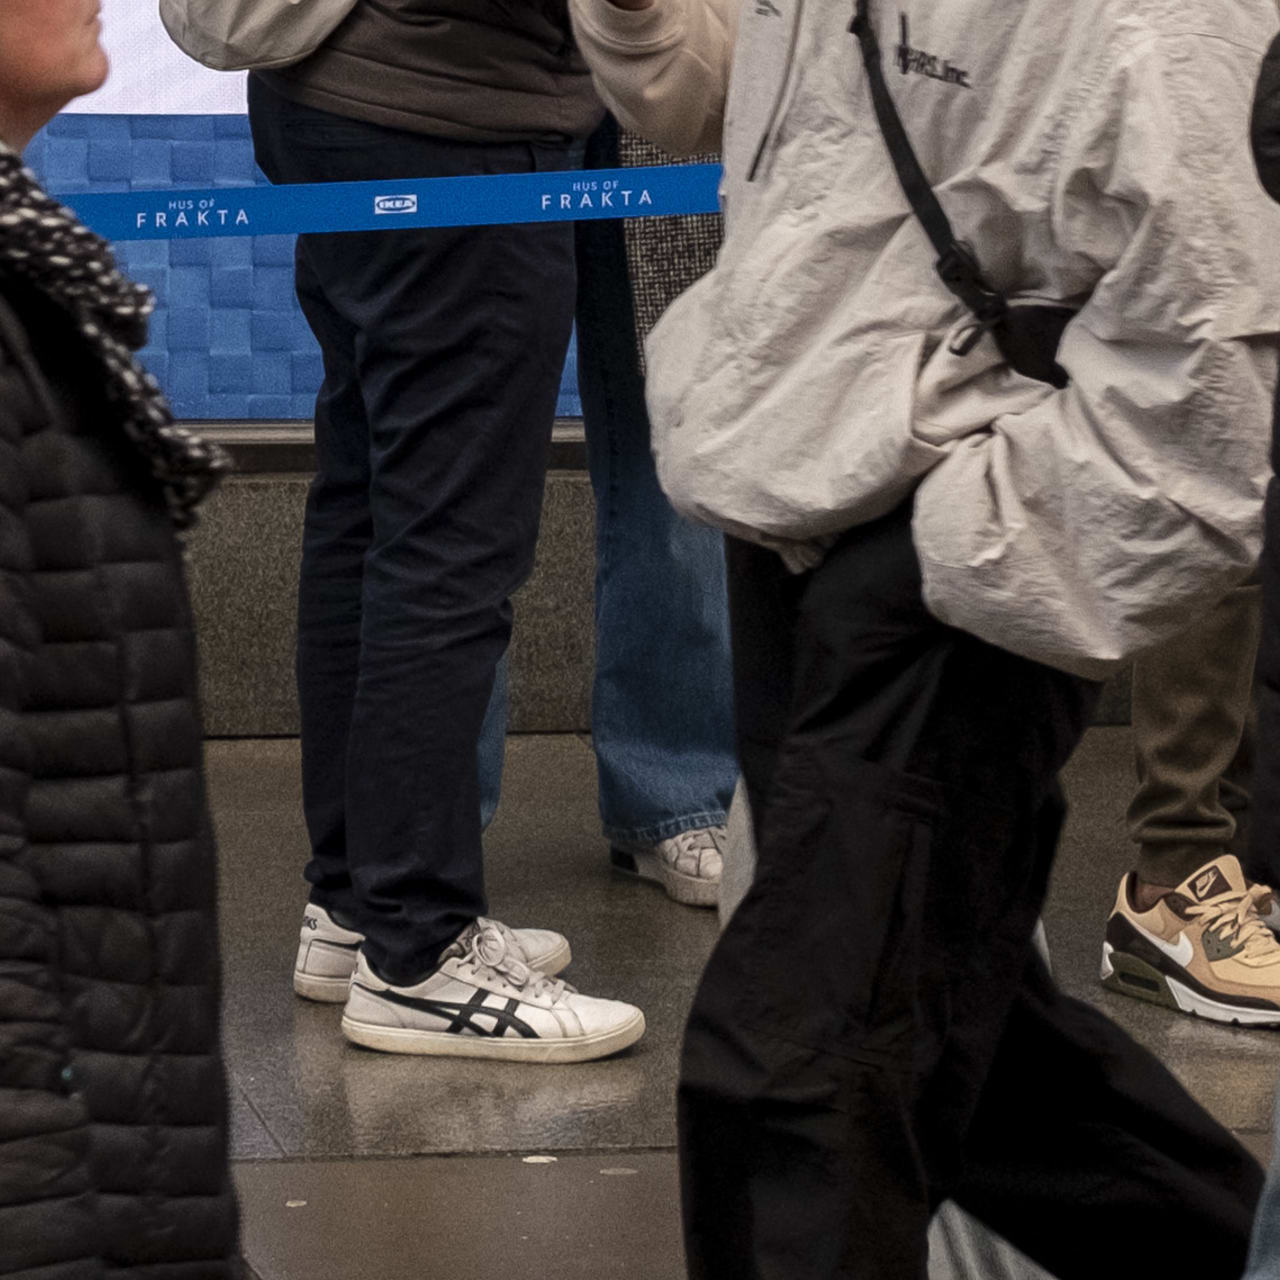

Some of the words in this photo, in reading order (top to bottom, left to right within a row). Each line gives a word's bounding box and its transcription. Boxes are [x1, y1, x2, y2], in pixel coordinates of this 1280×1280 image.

[572, 181, 598, 192] HUS
[602, 179, 619, 190] OF
[168, 199, 194, 210] HUS
[541, 189, 653, 210] FRAKTA
[136, 208, 249, 229] FRAKTA
